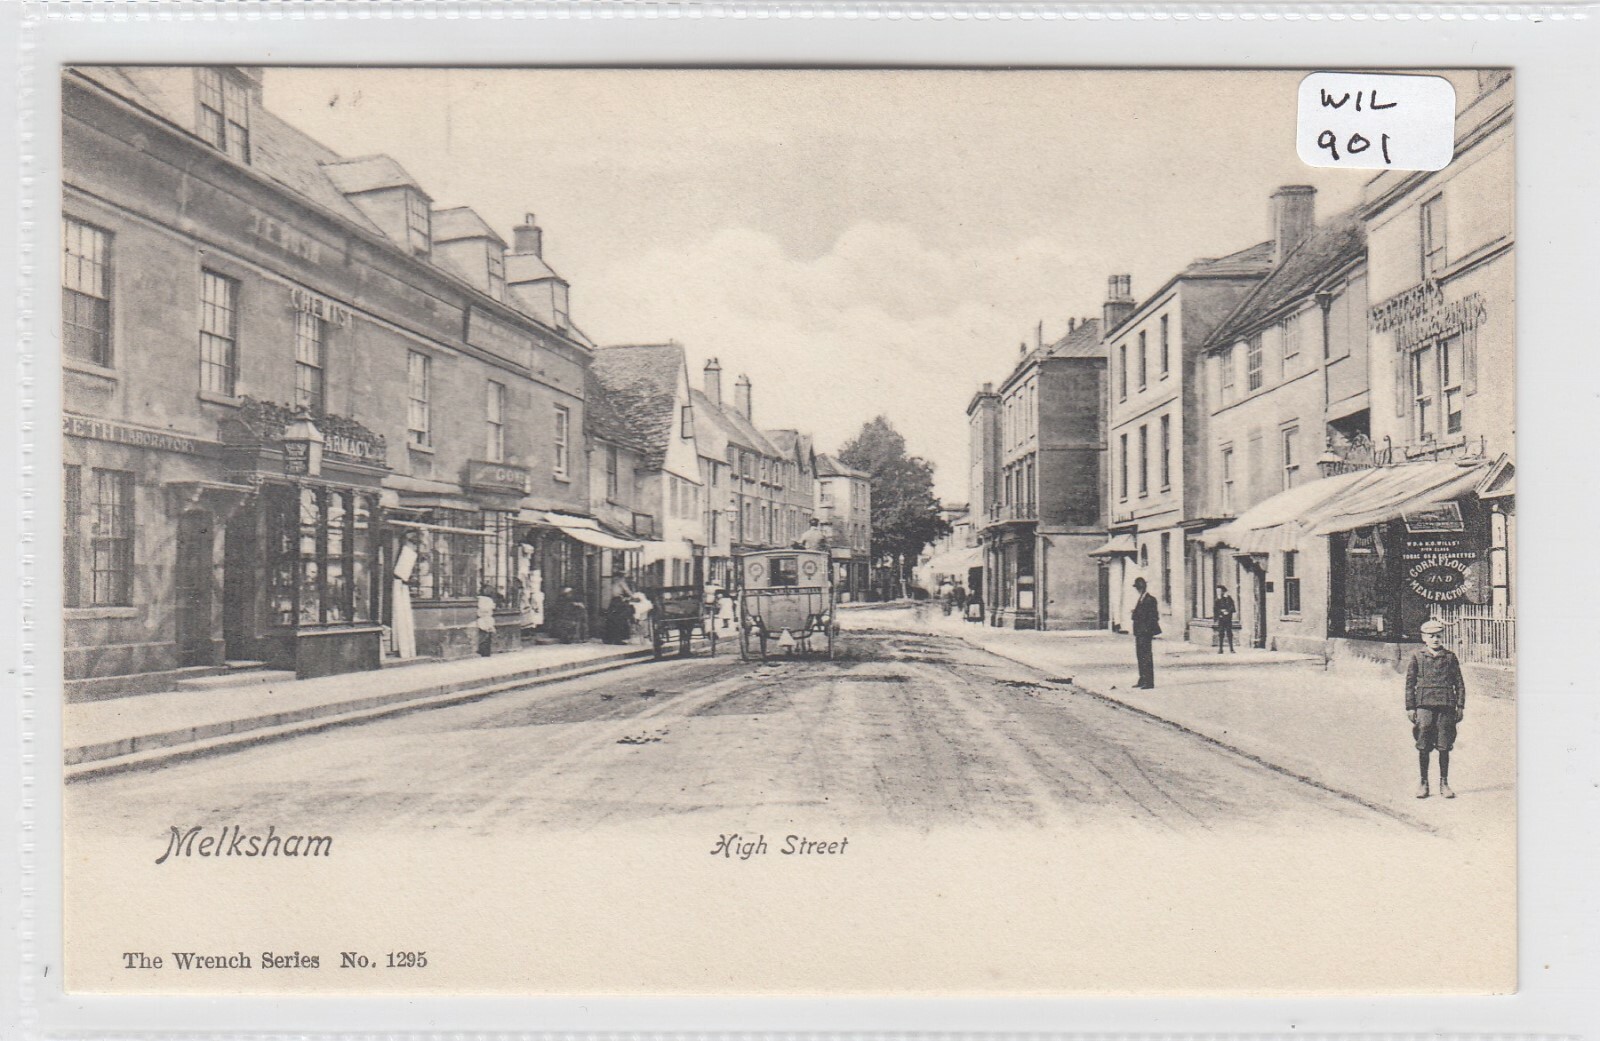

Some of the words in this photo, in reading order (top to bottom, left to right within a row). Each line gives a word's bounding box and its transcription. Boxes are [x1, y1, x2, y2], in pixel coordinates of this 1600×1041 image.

[1320, 88, 1398, 112] WIL
[1317, 129, 1392, 164] 901
[1438, 557, 1472, 577] FLOUR
[1409, 579, 1433, 599] MEAL
